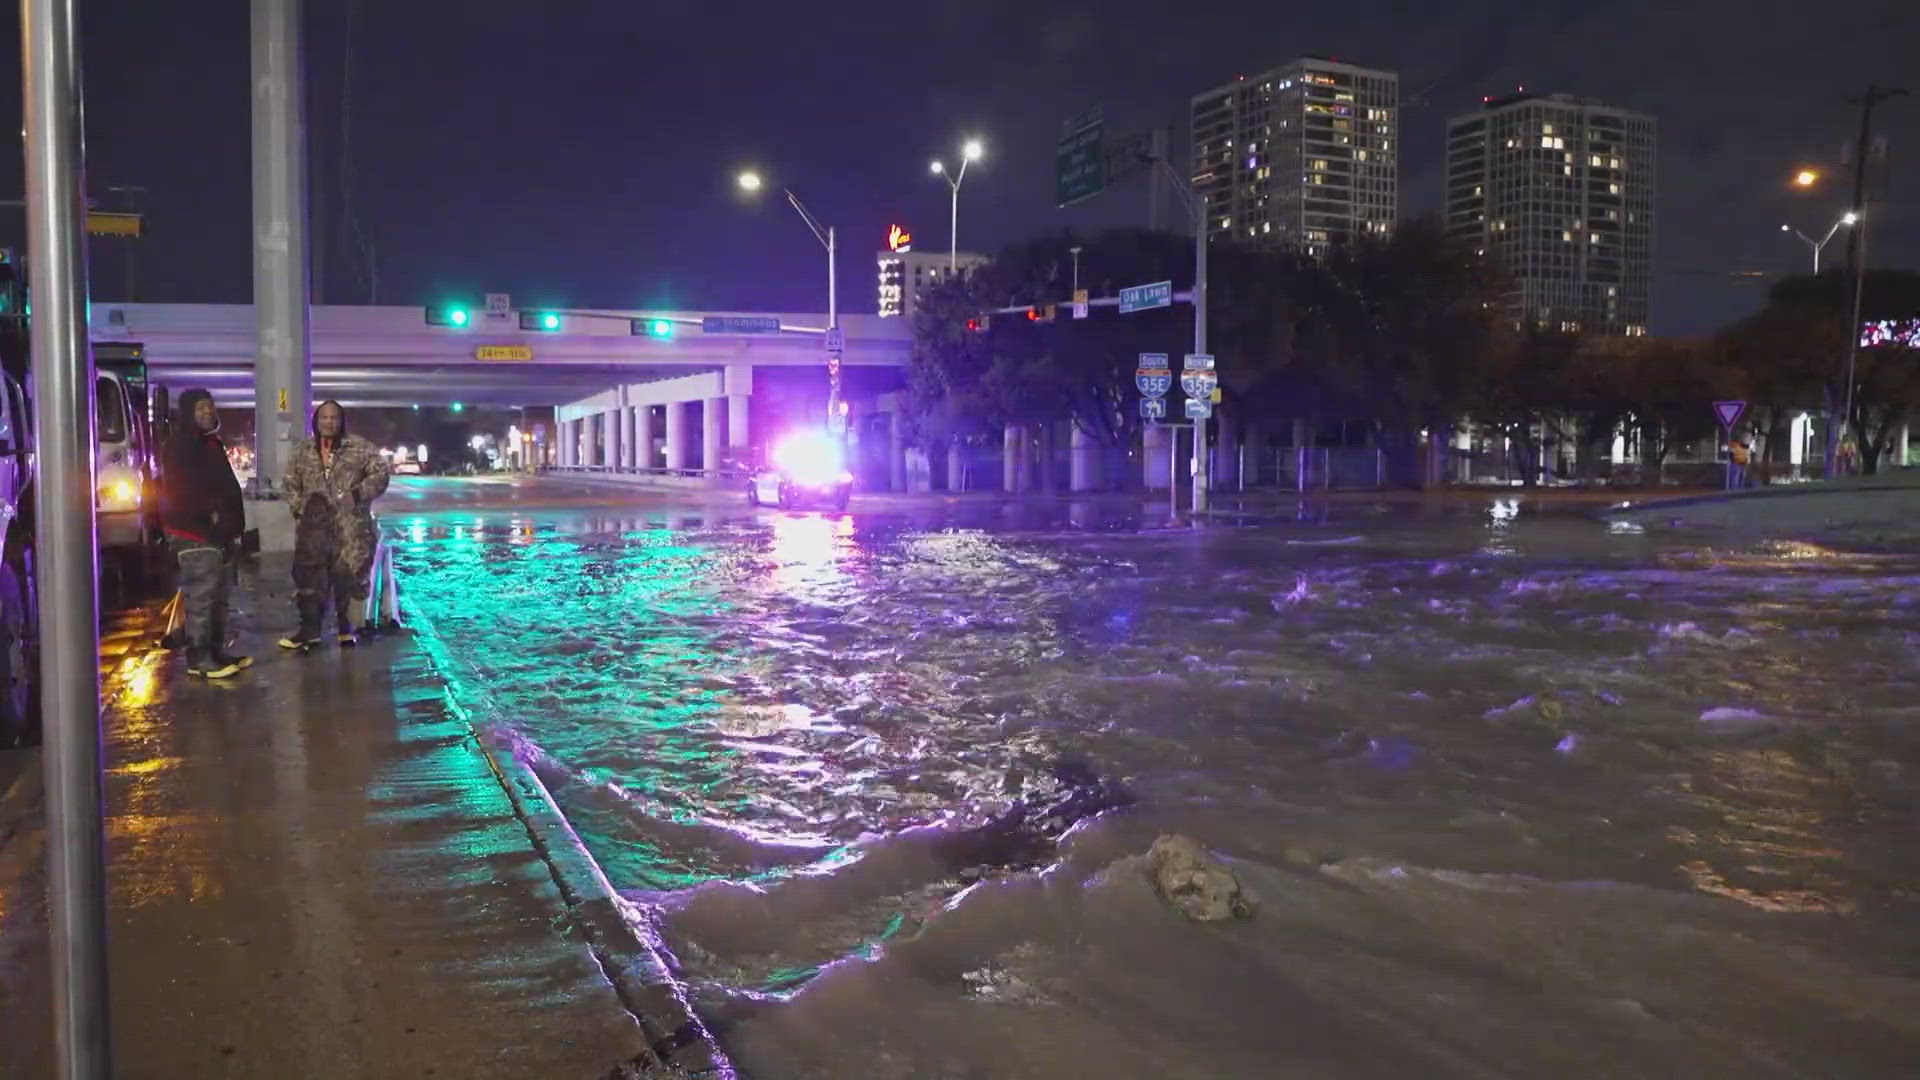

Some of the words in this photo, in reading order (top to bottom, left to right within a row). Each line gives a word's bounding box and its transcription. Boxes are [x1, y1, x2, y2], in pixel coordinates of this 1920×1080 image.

[1123, 289, 1139, 302] Oak
[1144, 286, 1168, 302] Lawn
[1141, 377, 1165, 391] 35E
[1187, 379, 1210, 392] 35E
